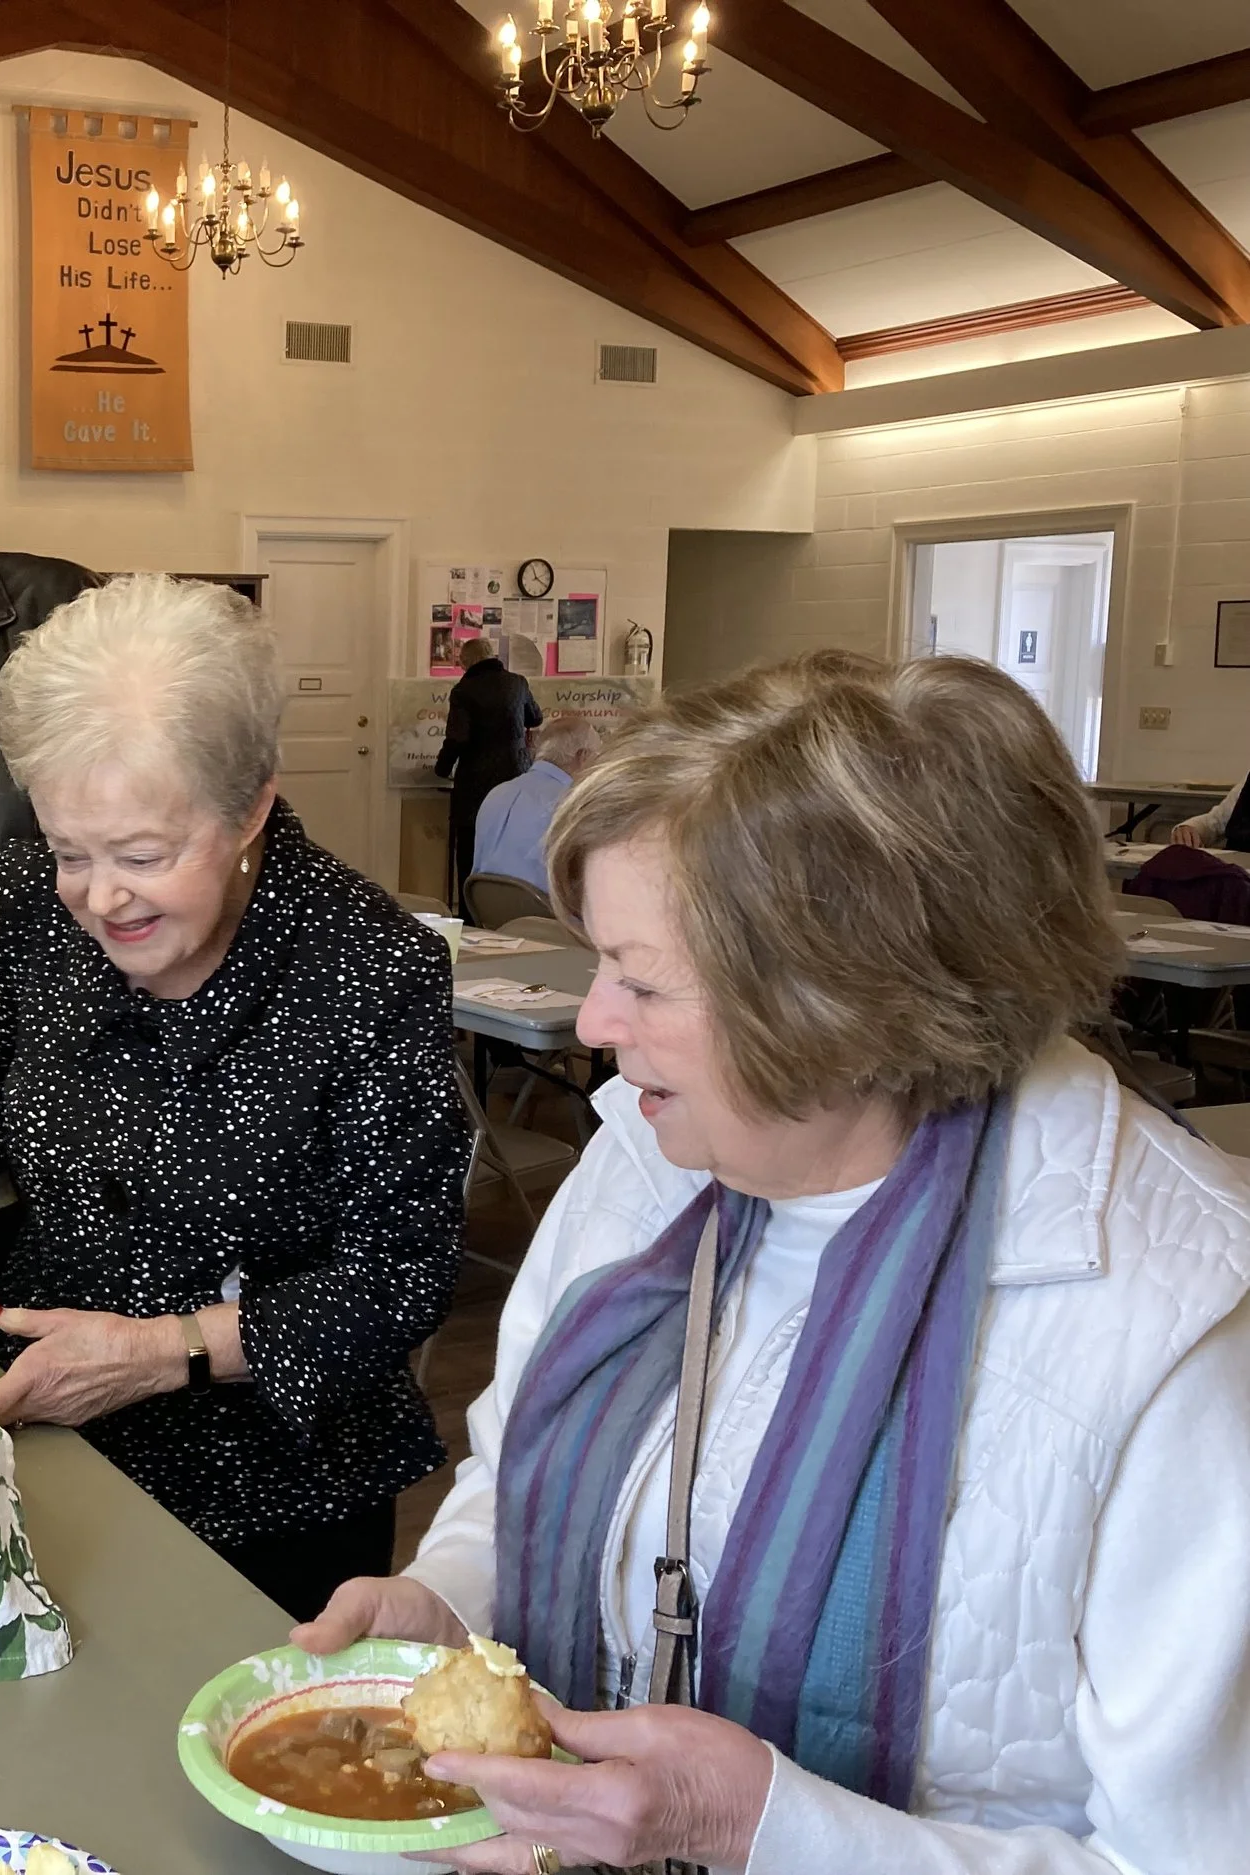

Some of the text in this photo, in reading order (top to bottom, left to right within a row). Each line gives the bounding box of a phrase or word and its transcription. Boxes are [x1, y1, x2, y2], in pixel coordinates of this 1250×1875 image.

[56, 150, 151, 192] Jesus
[77, 196, 142, 222] Didn't
[89, 231, 141, 256] Lose
[60, 265, 172, 291] His Life...
[64, 418, 157, 443] Gave It.
[556, 688, 622, 705] Worship
